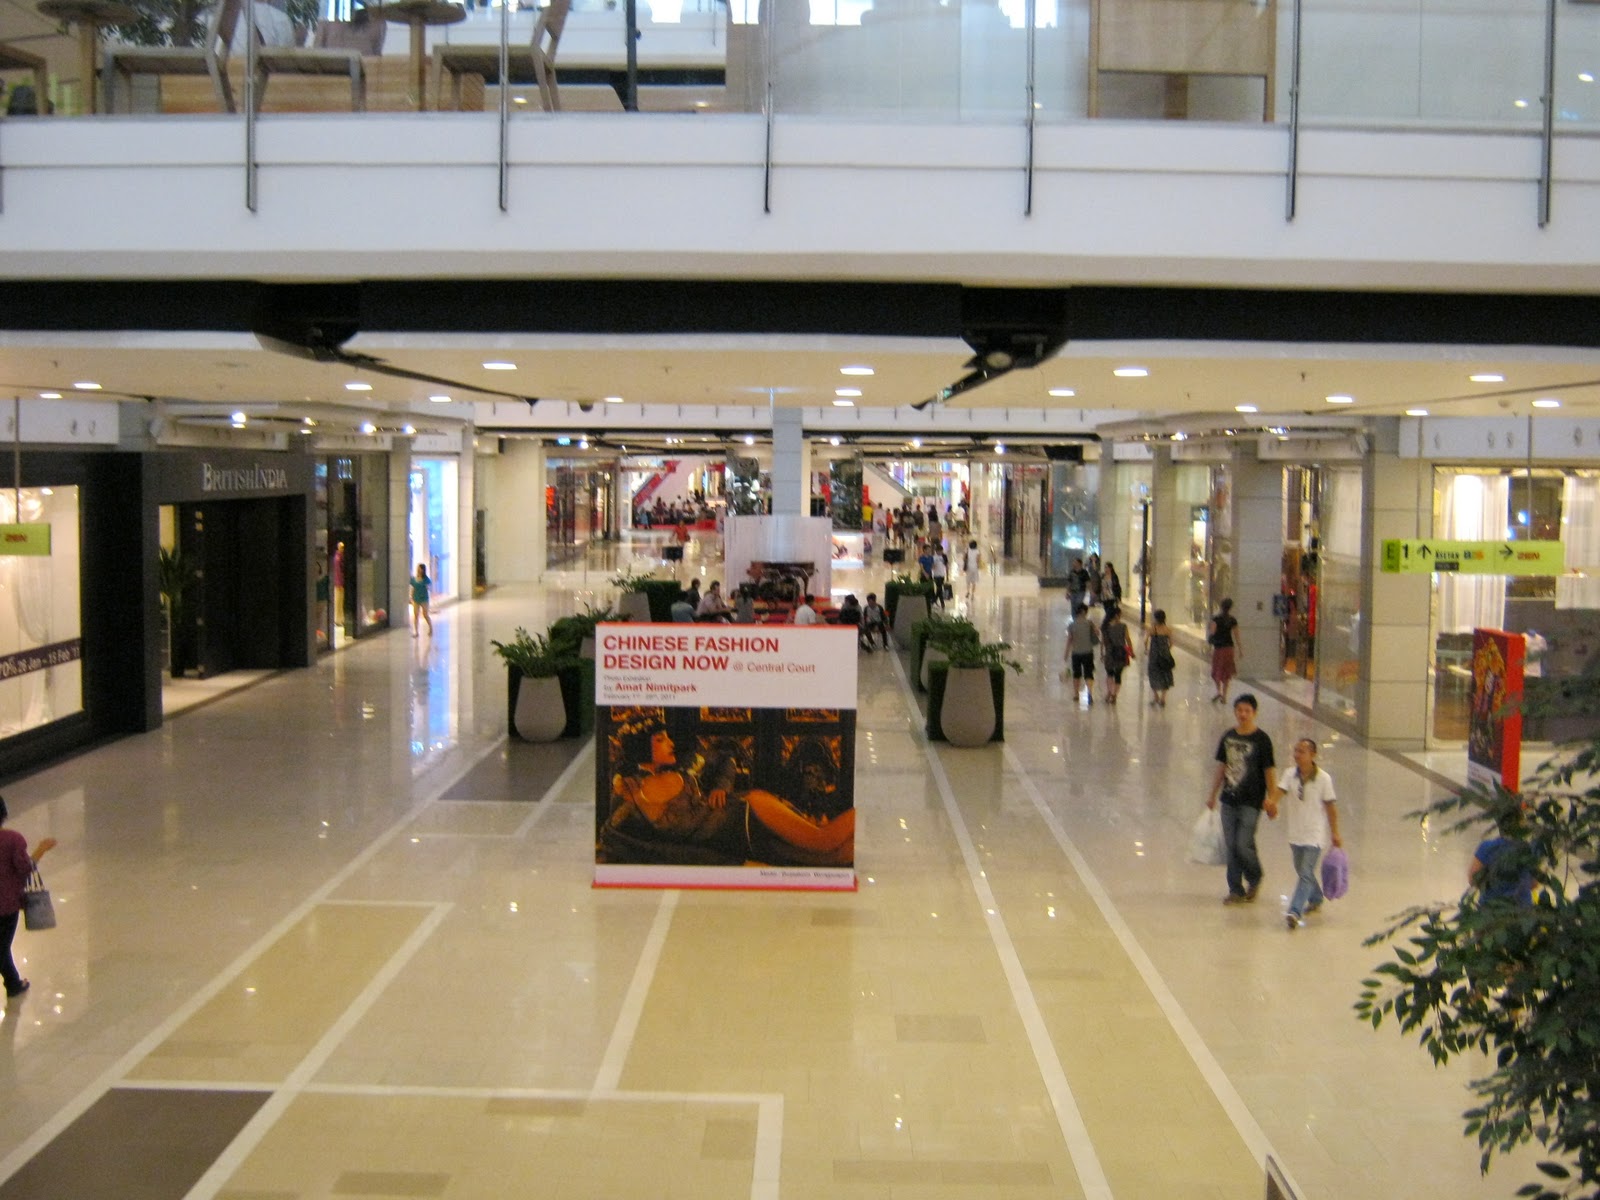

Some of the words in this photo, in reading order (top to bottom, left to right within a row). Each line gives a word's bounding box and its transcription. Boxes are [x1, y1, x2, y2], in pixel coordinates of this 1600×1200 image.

[1402, 544, 1409, 559] 1
[603, 635, 689, 651] CHINESE
[694, 637, 780, 653] FASHION
[603, 655, 676, 671] DESIGN
[682, 655, 729, 671] NOW
[747, 662, 785, 673] Central
[787, 663, 816, 673] Court
[615, 682, 643, 692] Amat
[646, 682, 697, 693] Nimitpark
